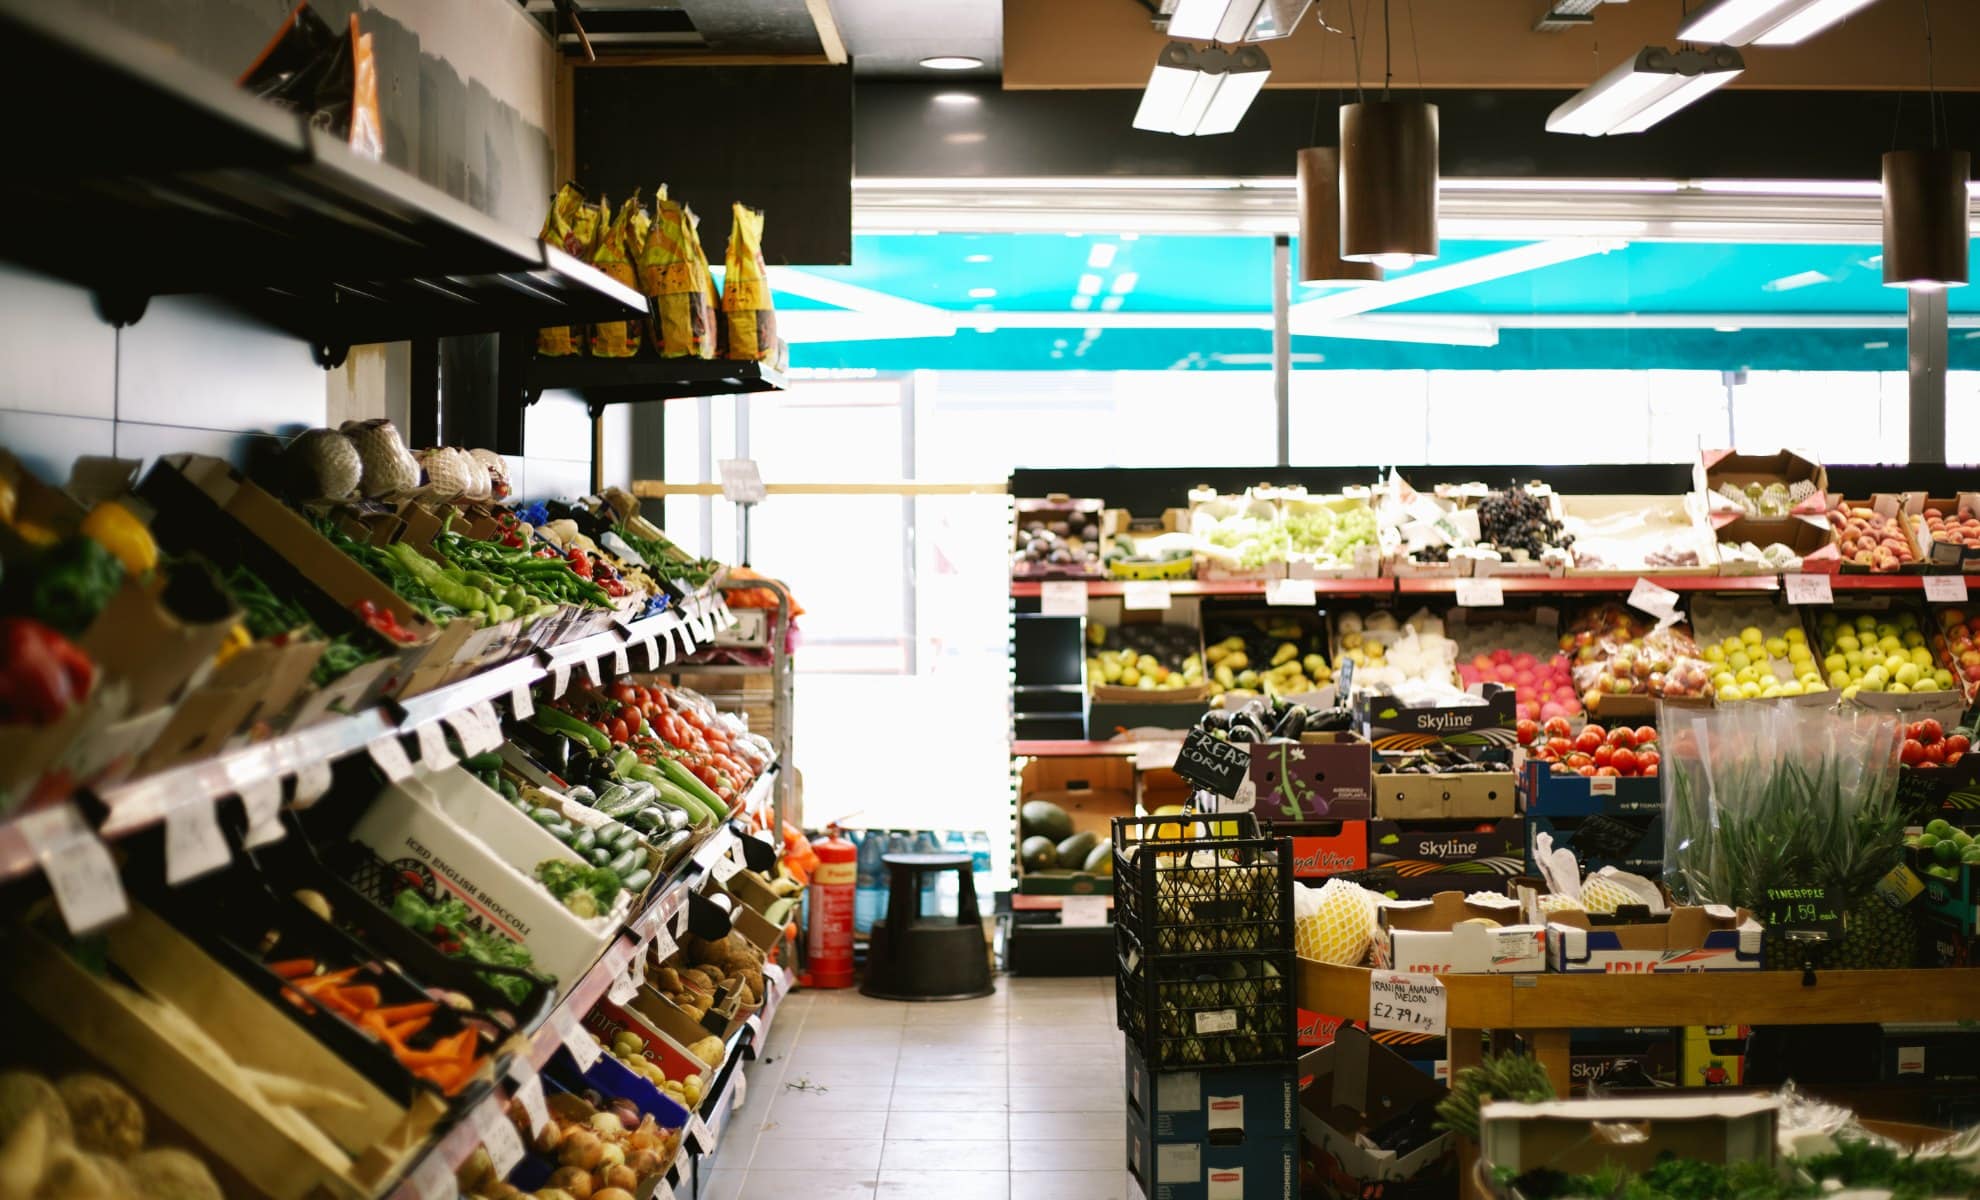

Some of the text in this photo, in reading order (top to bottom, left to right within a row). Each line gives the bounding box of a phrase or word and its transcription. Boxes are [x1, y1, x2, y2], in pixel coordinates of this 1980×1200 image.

[1417, 711, 1472, 731] Skyline
[1182, 747, 1230, 776] CORN
[1419, 839, 1478, 858] Skyline
[1322, 852, 1355, 867] Vine
[406, 837, 432, 860] ICED
[432, 857, 478, 895] ENGLISH
[478, 891, 532, 936] BROCCOLI
[1767, 888, 1825, 901] PINEAPPLE
[1372, 980, 1406, 993] IRANIAN
[1409, 984, 1440, 996] ANANAS
[1394, 992, 1428, 1004] MELON
[1373, 1002, 1412, 1023] £2.79
[1572, 1062, 1611, 1081] Skyl
[1284, 1080, 1292, 1130] PROMINENT
